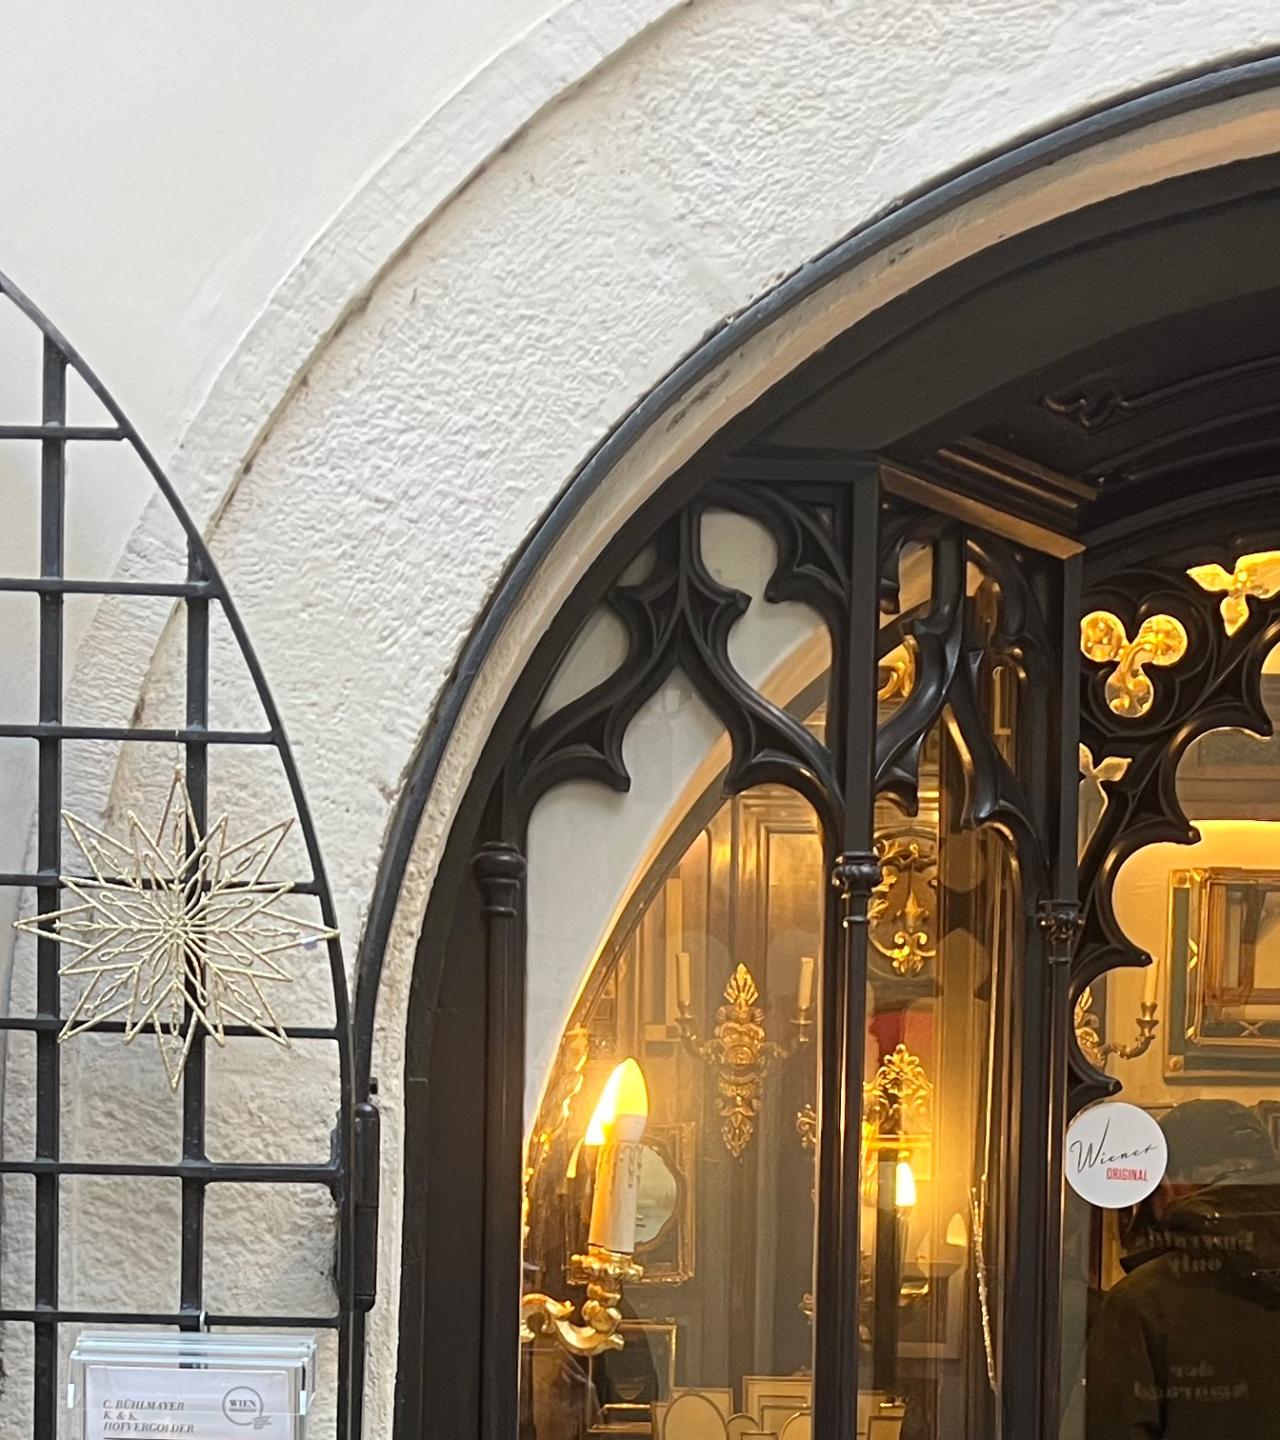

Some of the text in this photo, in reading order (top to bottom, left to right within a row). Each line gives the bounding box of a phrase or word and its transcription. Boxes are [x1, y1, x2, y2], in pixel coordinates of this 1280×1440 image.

[1069, 1118, 1159, 1173] Wiener
[1106, 1167, 1148, 1181] ORIGINAL
[115, 1398, 185, 1411] BÜHLMAYER
[229, 1400, 256, 1408] WIEN
[116, 1411, 126, 1420] &
[103, 1422, 195, 1434] HOFVERGOLDER
